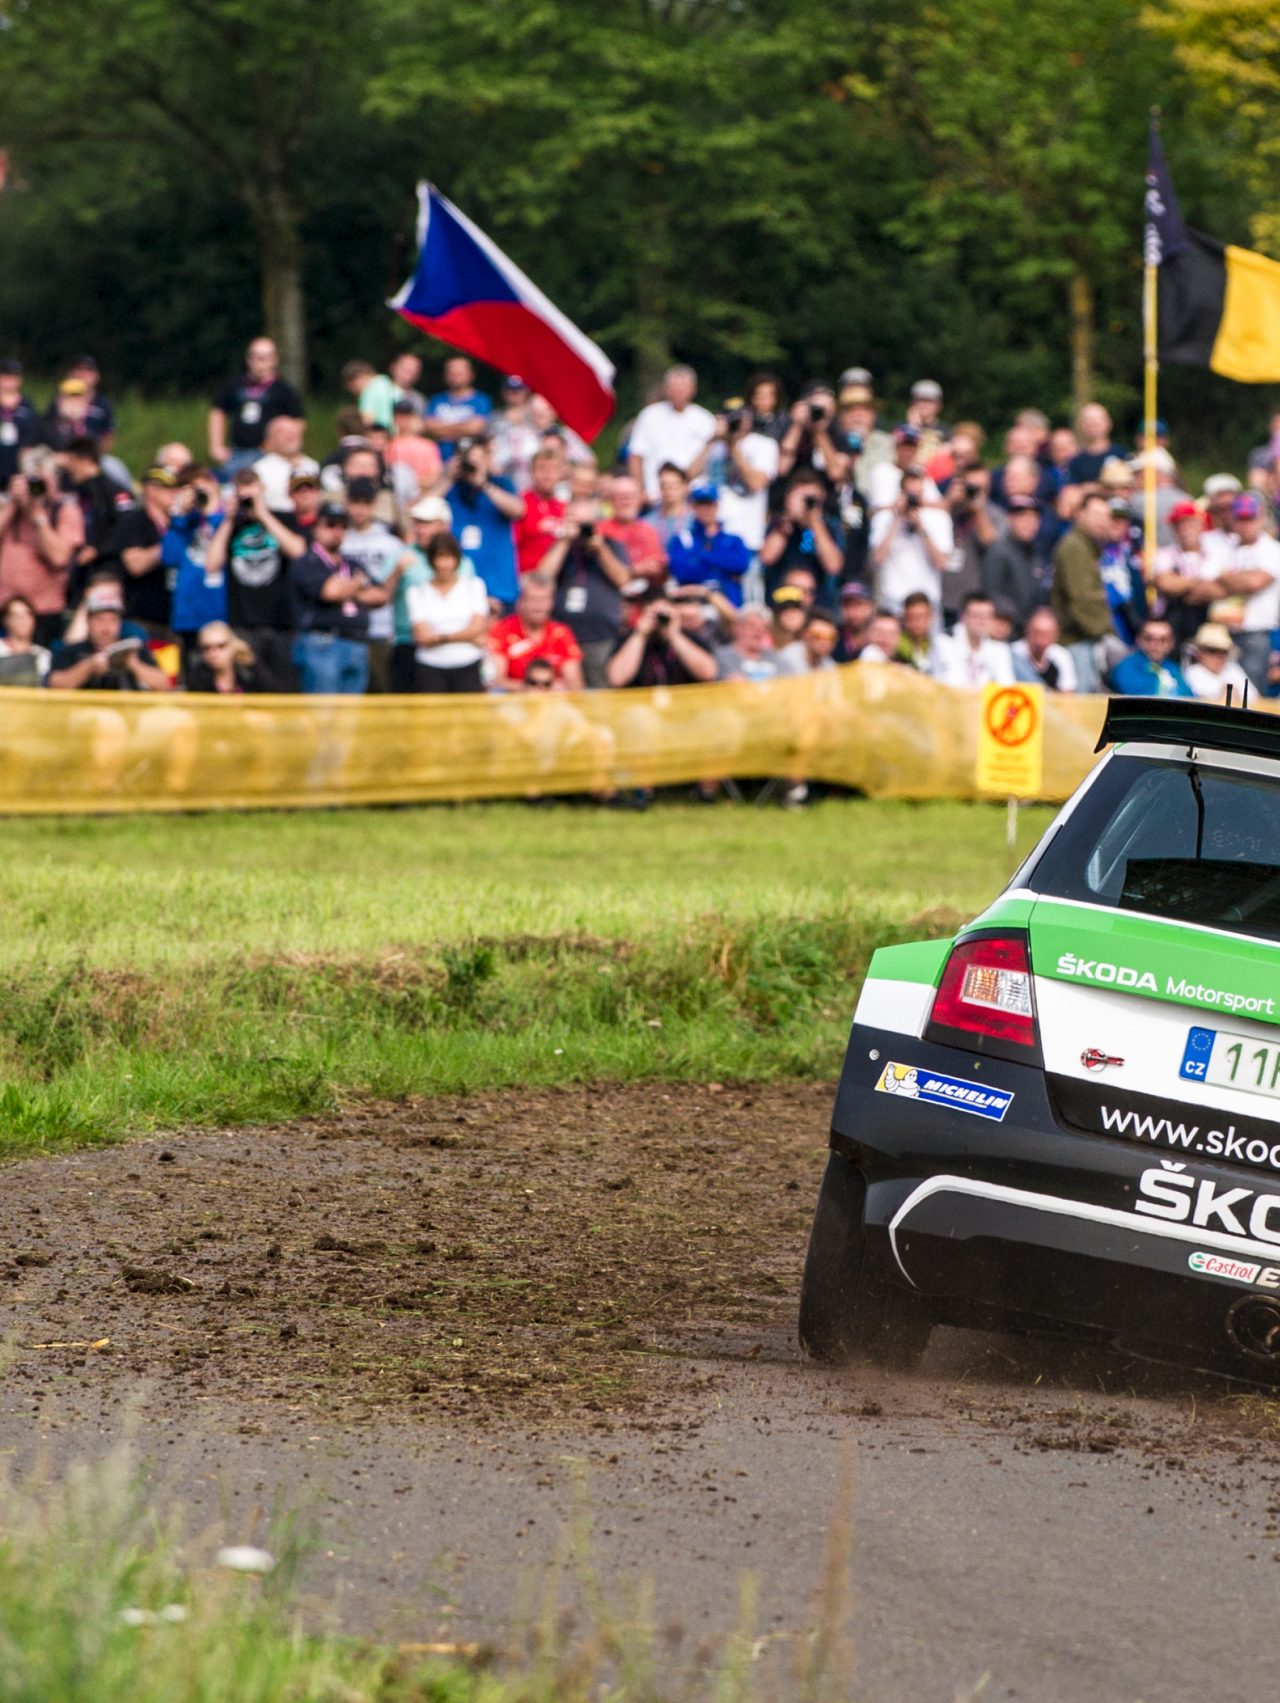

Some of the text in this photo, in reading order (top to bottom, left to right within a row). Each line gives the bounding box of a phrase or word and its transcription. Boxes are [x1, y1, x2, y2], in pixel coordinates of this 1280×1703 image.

[1056, 952, 1275, 1015] ŠKODA Motorsport
[1185, 1060, 1205, 1076] CZ
[923, 1079, 1009, 1109] MICHELIN
[1205, 1257, 1255, 1280] Castrol
